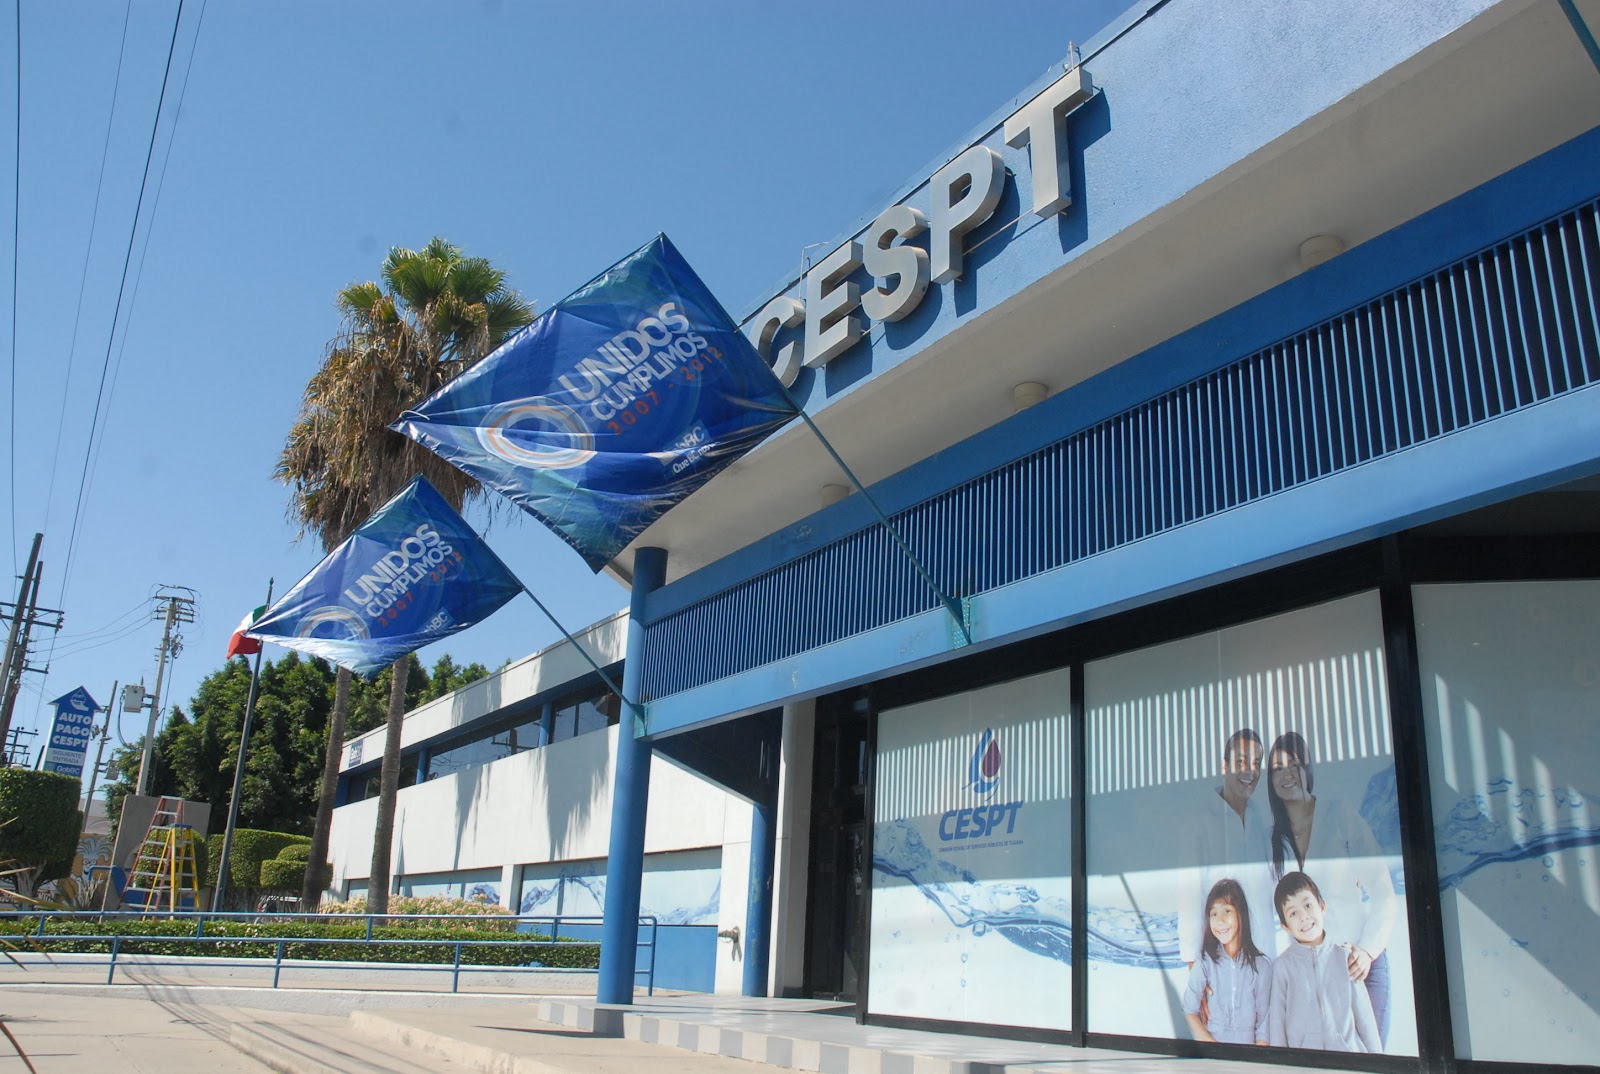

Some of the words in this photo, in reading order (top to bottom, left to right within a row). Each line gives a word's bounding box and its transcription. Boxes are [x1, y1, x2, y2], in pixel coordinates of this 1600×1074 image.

[750, 65, 1093, 388] CESPT
[557, 302, 690, 401] UNIDOS
[590, 332, 708, 421] CUMPLIMOS
[607, 390, 660, 435] 2007
[679, 346, 723, 381] 2012
[344, 523, 441, 607] UNIDOS
[366, 540, 453, 618] CUMPLIMOS
[378, 591, 416, 628] 2007
[428, 551, 464, 582] 2012
[52, 736, 87, 747] CESPT
[52, 750, 82, 758] SIGUIENTE
[56, 723, 90, 736] PAGO
[59, 712, 92, 725] AUTO
[52, 756, 79, 764] ENTRADA
[939, 801, 1024, 841] CESPT
